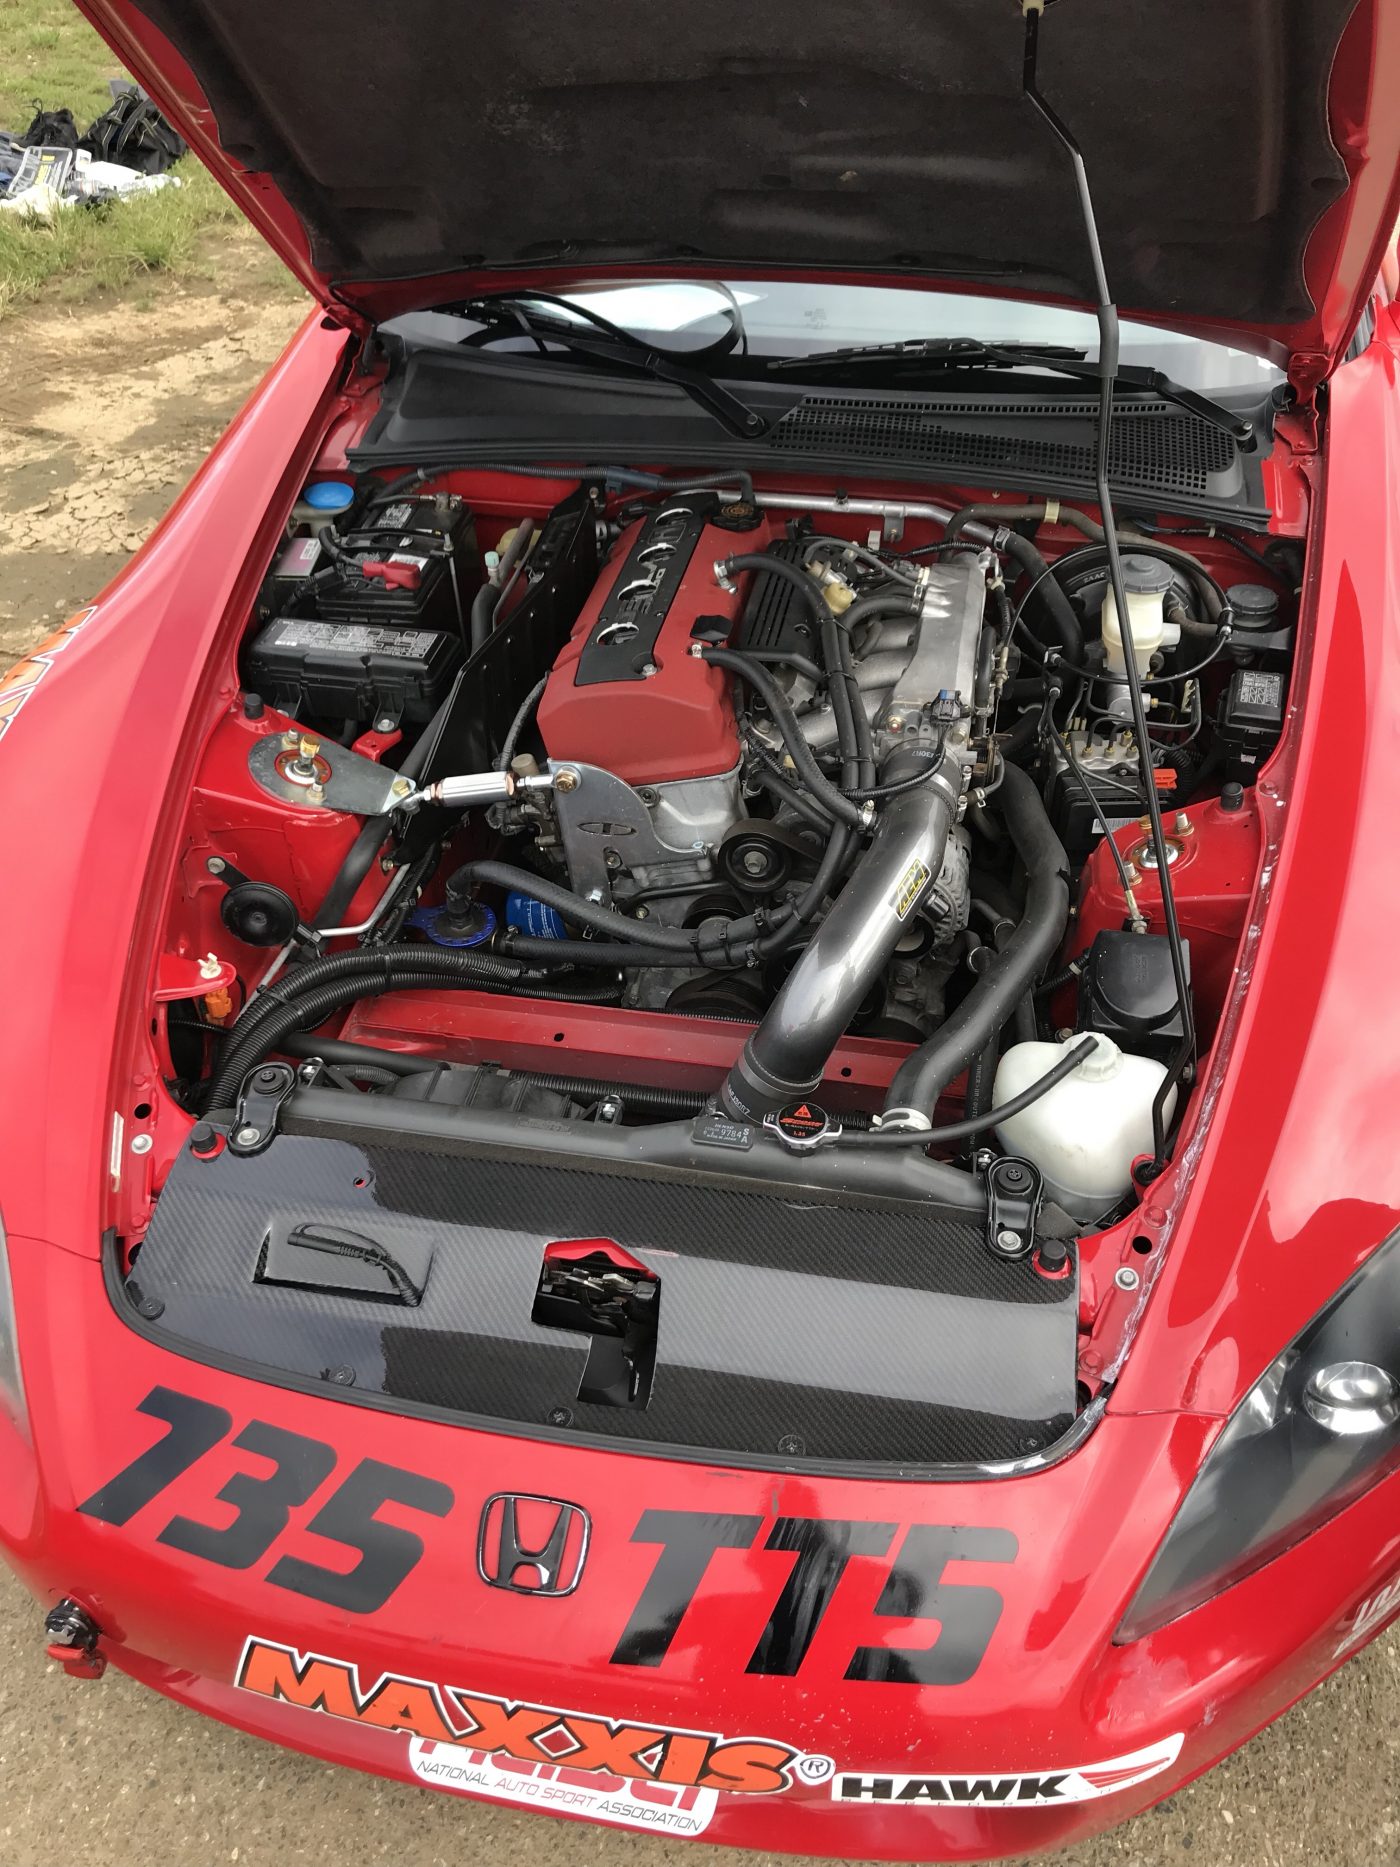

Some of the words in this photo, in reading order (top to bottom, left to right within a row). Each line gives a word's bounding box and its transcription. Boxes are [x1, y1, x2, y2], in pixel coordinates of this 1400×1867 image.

[897, 858, 926, 913] AEM
[720, 1128, 742, 1139] 9784
[76, 1384, 455, 1615] 735
[608, 1508, 1020, 1687] TT5
[236, 1636, 793, 1794] MAXXIS
[416, 1760, 489, 1786] NATIONAL
[494, 1777, 540, 1797] AUTO
[539, 1786, 599, 1809] SPORT
[595, 1799, 703, 1832] ASSOCIATION
[841, 1773, 1071, 1801] HAWK
